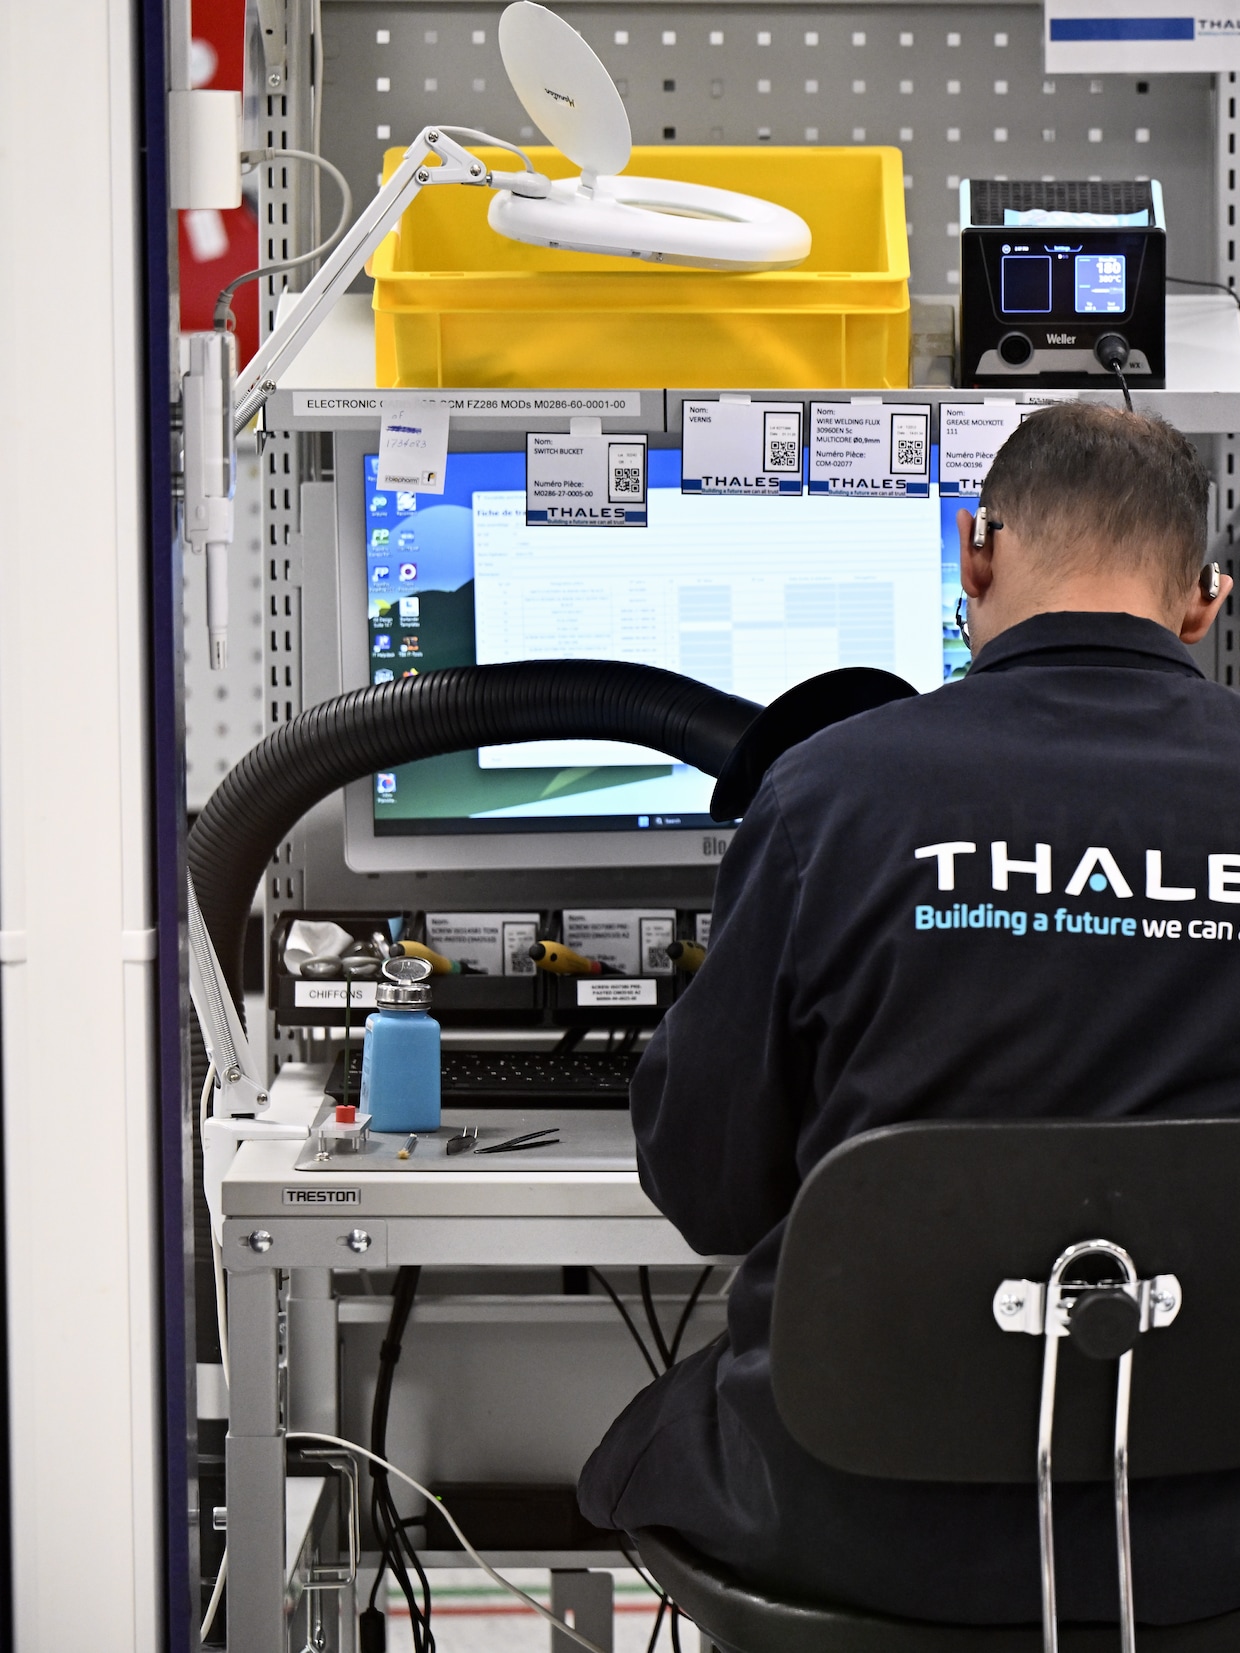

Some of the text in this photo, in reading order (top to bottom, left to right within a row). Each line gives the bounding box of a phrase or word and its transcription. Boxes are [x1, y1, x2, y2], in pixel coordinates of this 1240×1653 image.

[1096, 262, 1122, 274] 180
[1046, 334, 1076, 344] Weller
[308, 400, 376, 409] ELECTRONIC
[468, 400, 498, 409] FZ286
[501, 400, 531, 409] MODs
[534, 400, 626, 409] M0286-60-0001-00
[702, 476, 779, 486] THALES
[829, 478, 906, 488] THALES
[547, 508, 625, 517] THALES
[915, 903, 1027, 936] Building
[1033, 913, 1048, 932] a
[1054, 908, 1137, 936] future
[1142, 918, 1182, 939] we
[1188, 919, 1233, 941] can
[309, 990, 363, 999] CHIFFONS
[286, 1191, 356, 1202] TRESTON
